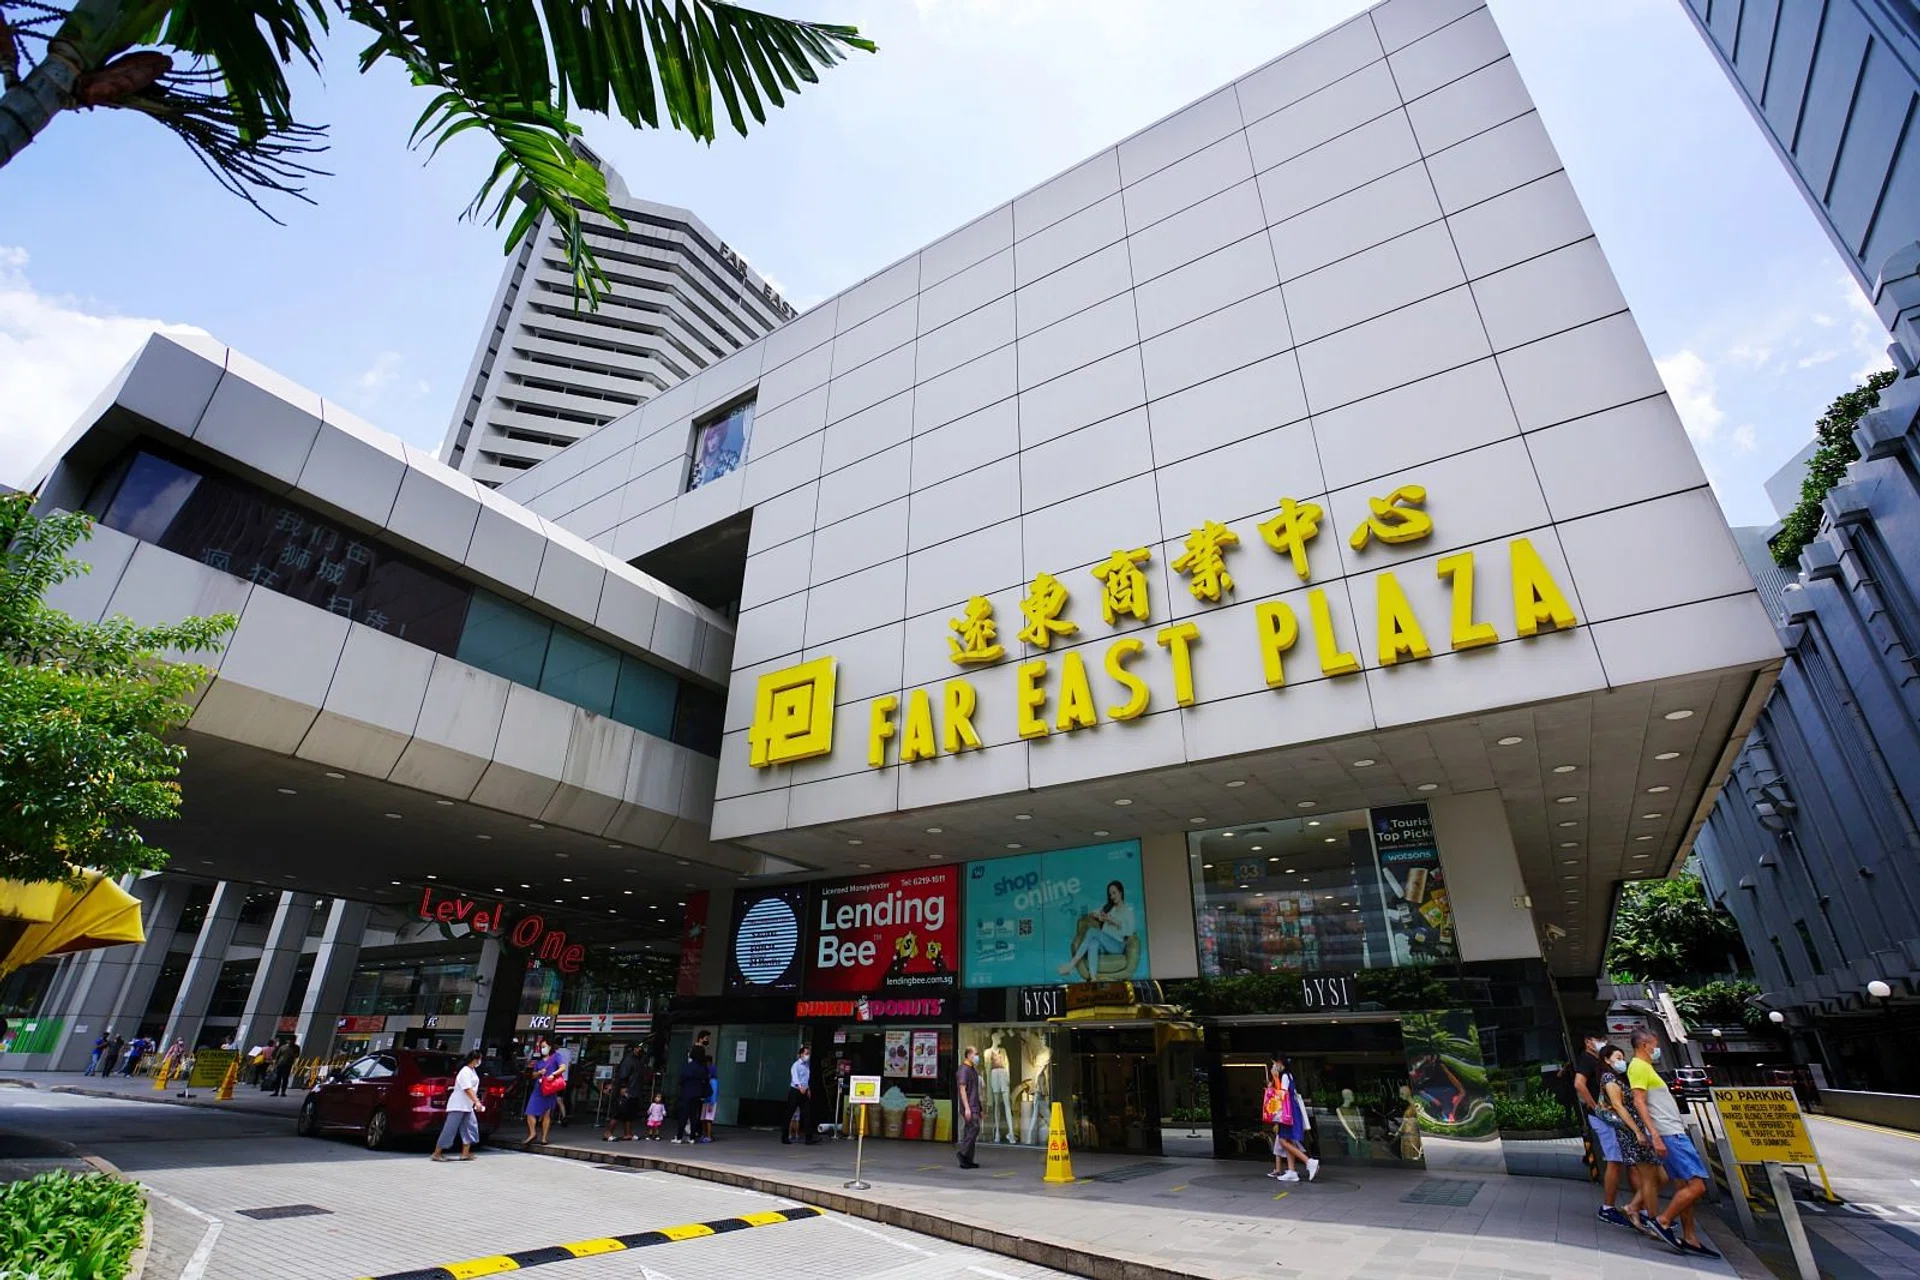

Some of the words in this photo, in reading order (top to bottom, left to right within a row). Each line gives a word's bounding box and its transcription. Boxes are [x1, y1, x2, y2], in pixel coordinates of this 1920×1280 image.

[719, 241, 748, 278] FAR
[763, 282, 799, 320] EAST
[275, 507, 372, 567] 我们在
[279, 542, 347, 587] 狮城
[868, 679, 982, 768] FAR
[1017, 622, 1201, 741] EAST
[1255, 537, 1578, 690] PLAZA
[1376, 831, 1400, 843] Top
[1389, 816, 1432, 829] Touris
[821, 885, 849, 896] Licensed
[849, 881, 890, 893] Moneylender
[993, 871, 1039, 896] shop
[1014, 877, 1081, 911] online
[419, 887, 504, 933] Level
[820, 890, 945, 931] Lending
[512, 914, 586, 973] One
[817, 934, 877, 969] Bee
[886, 975, 953, 987] lendingbee.com.sg
[529, 1016, 552, 1029] KFC
[871, 999, 943, 1017] DONUTS
[1714, 1091, 1733, 1100] NO
[1737, 1090, 1793, 1100] PARKING
